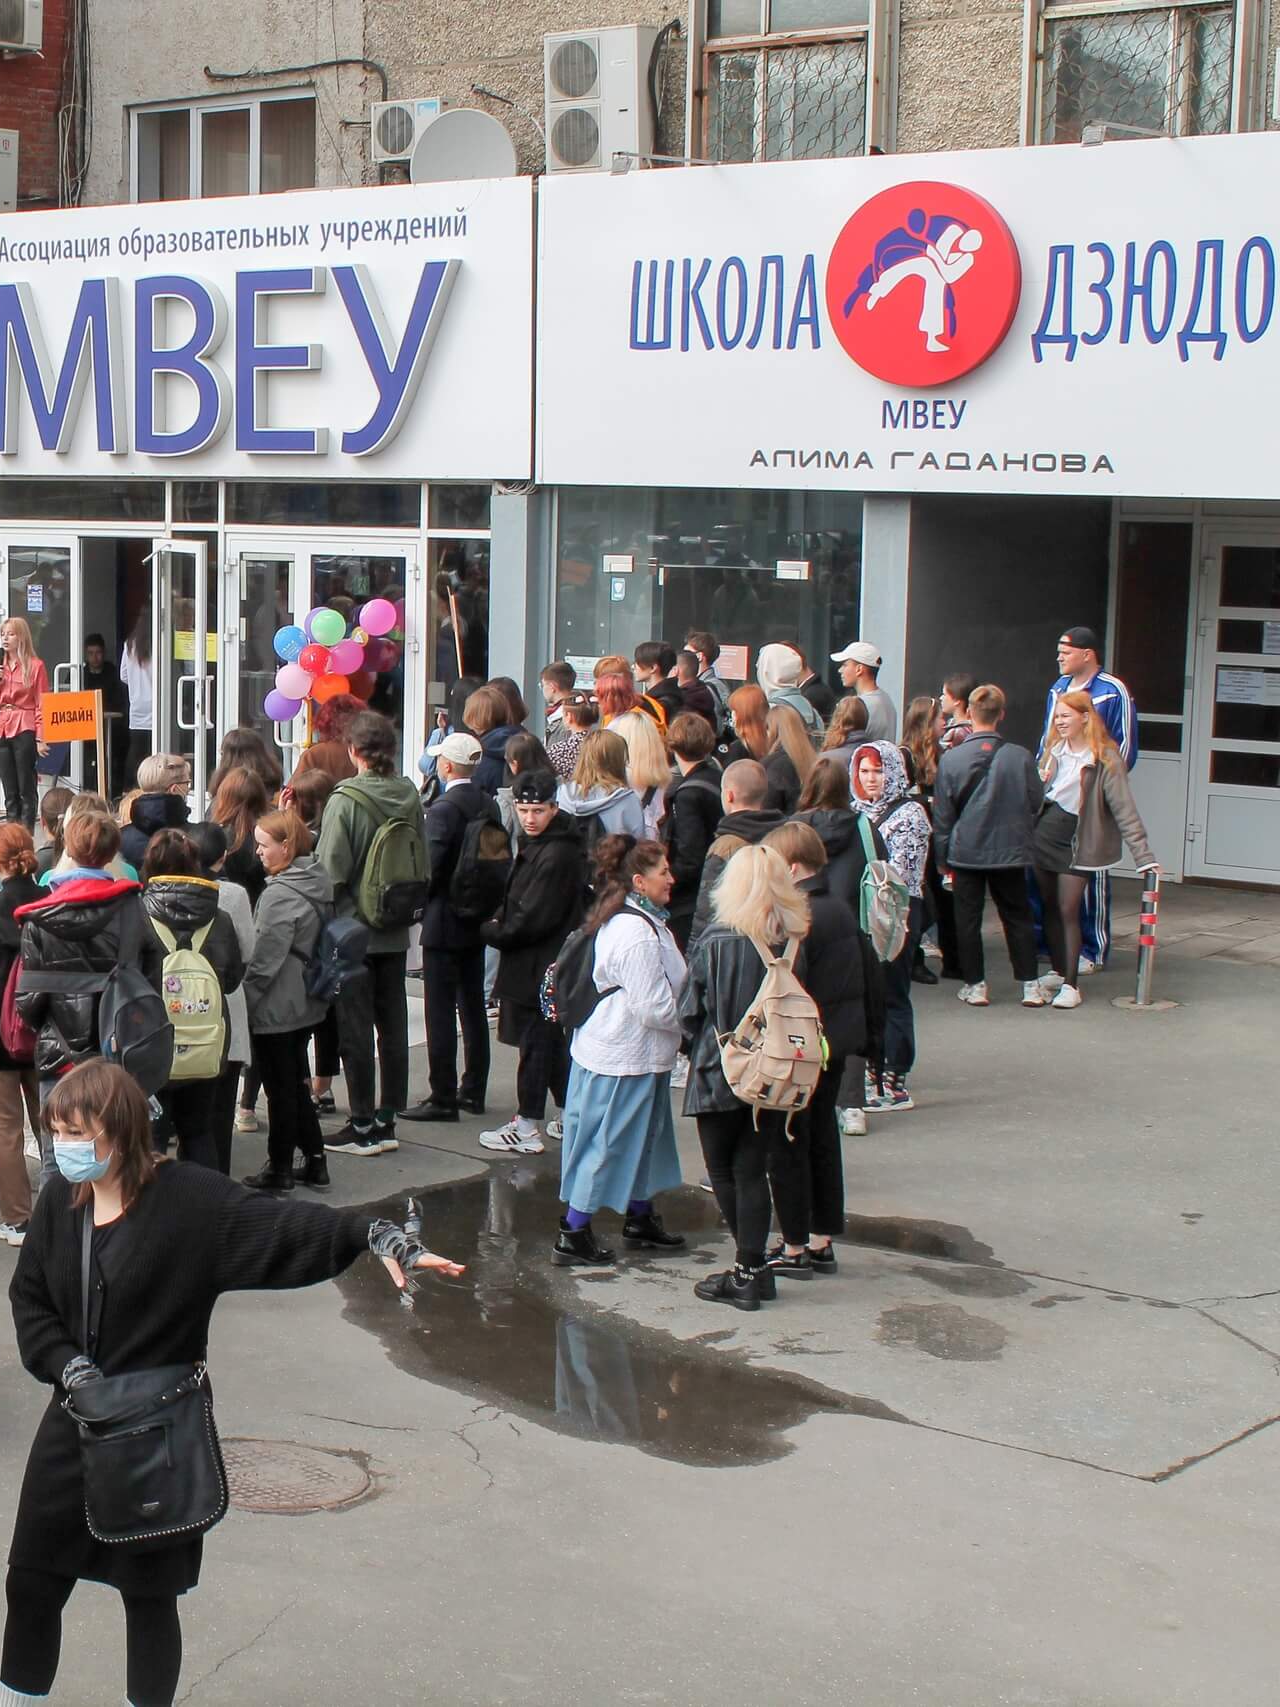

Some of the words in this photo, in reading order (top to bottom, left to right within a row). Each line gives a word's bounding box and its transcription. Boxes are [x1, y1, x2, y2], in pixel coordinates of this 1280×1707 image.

[118, 222, 310, 263] образовательных
[320, 207, 468, 251] учреждений
[629, 253, 822, 352] ШКОЛА
[1031, 235, 1277, 364] ДЗЮДО
[880, 399, 968, 430] МВЕУ
[890, 451, 1115, 474] ГАДАНОВА
[51, 707, 93, 726] ДИЗАЙН
